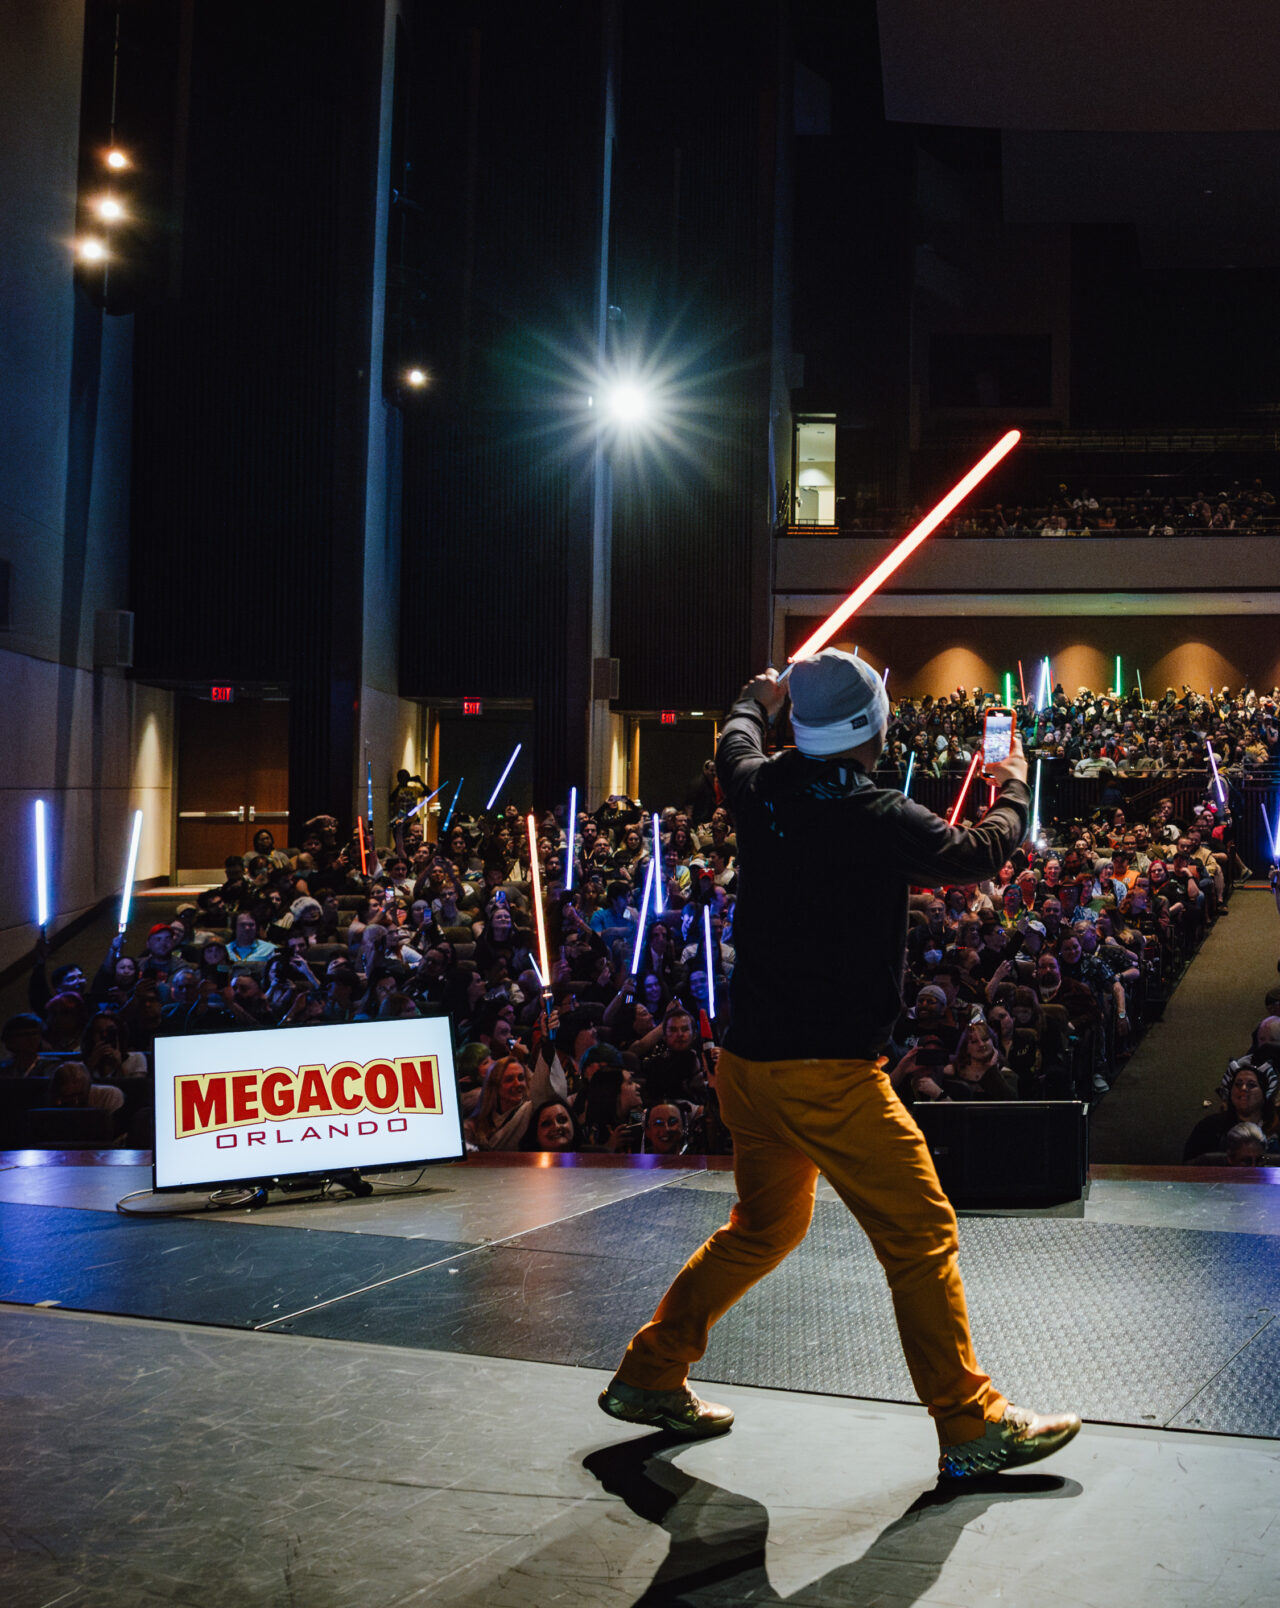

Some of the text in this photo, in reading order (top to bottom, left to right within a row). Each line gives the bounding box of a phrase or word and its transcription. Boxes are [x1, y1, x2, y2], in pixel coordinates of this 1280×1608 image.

[211, 687, 231, 700] EXIT
[463, 702, 480, 714] EXIT
[178, 1058, 440, 1135] MEGACON
[216, 1118, 408, 1149] ORLANDO
